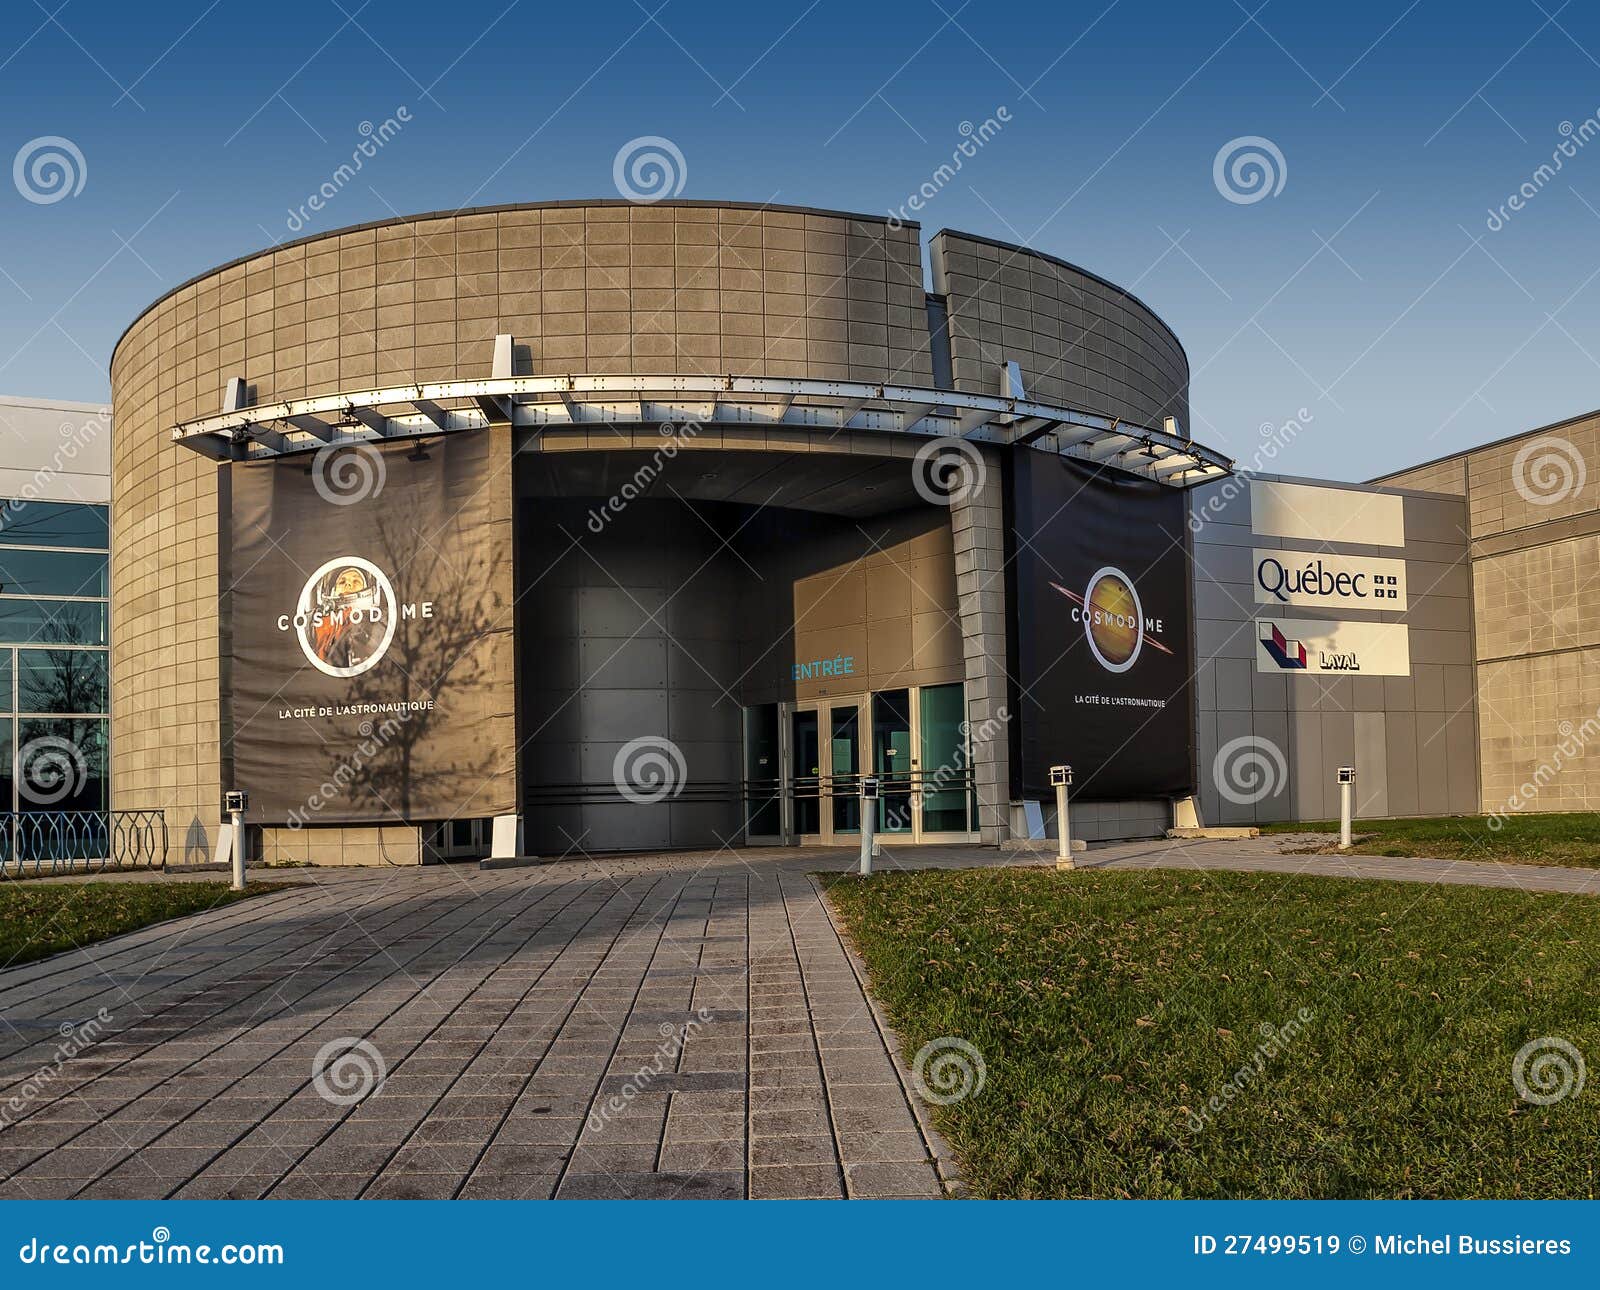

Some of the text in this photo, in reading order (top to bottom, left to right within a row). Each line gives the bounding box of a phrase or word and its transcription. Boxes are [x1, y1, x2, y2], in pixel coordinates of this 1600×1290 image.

[1257, 558, 1367, 602] Québec
[791, 653, 855, 680] ENTRÉE
[1319, 651, 1360, 670] LAVAL
[1074, 695, 1084, 704] LA
[1085, 694, 1100, 704] CITÉ
[1101, 696, 1110, 705] DE
[279, 700, 434, 719] LA CITÉ DE L'ASTRONAUTIQUE
